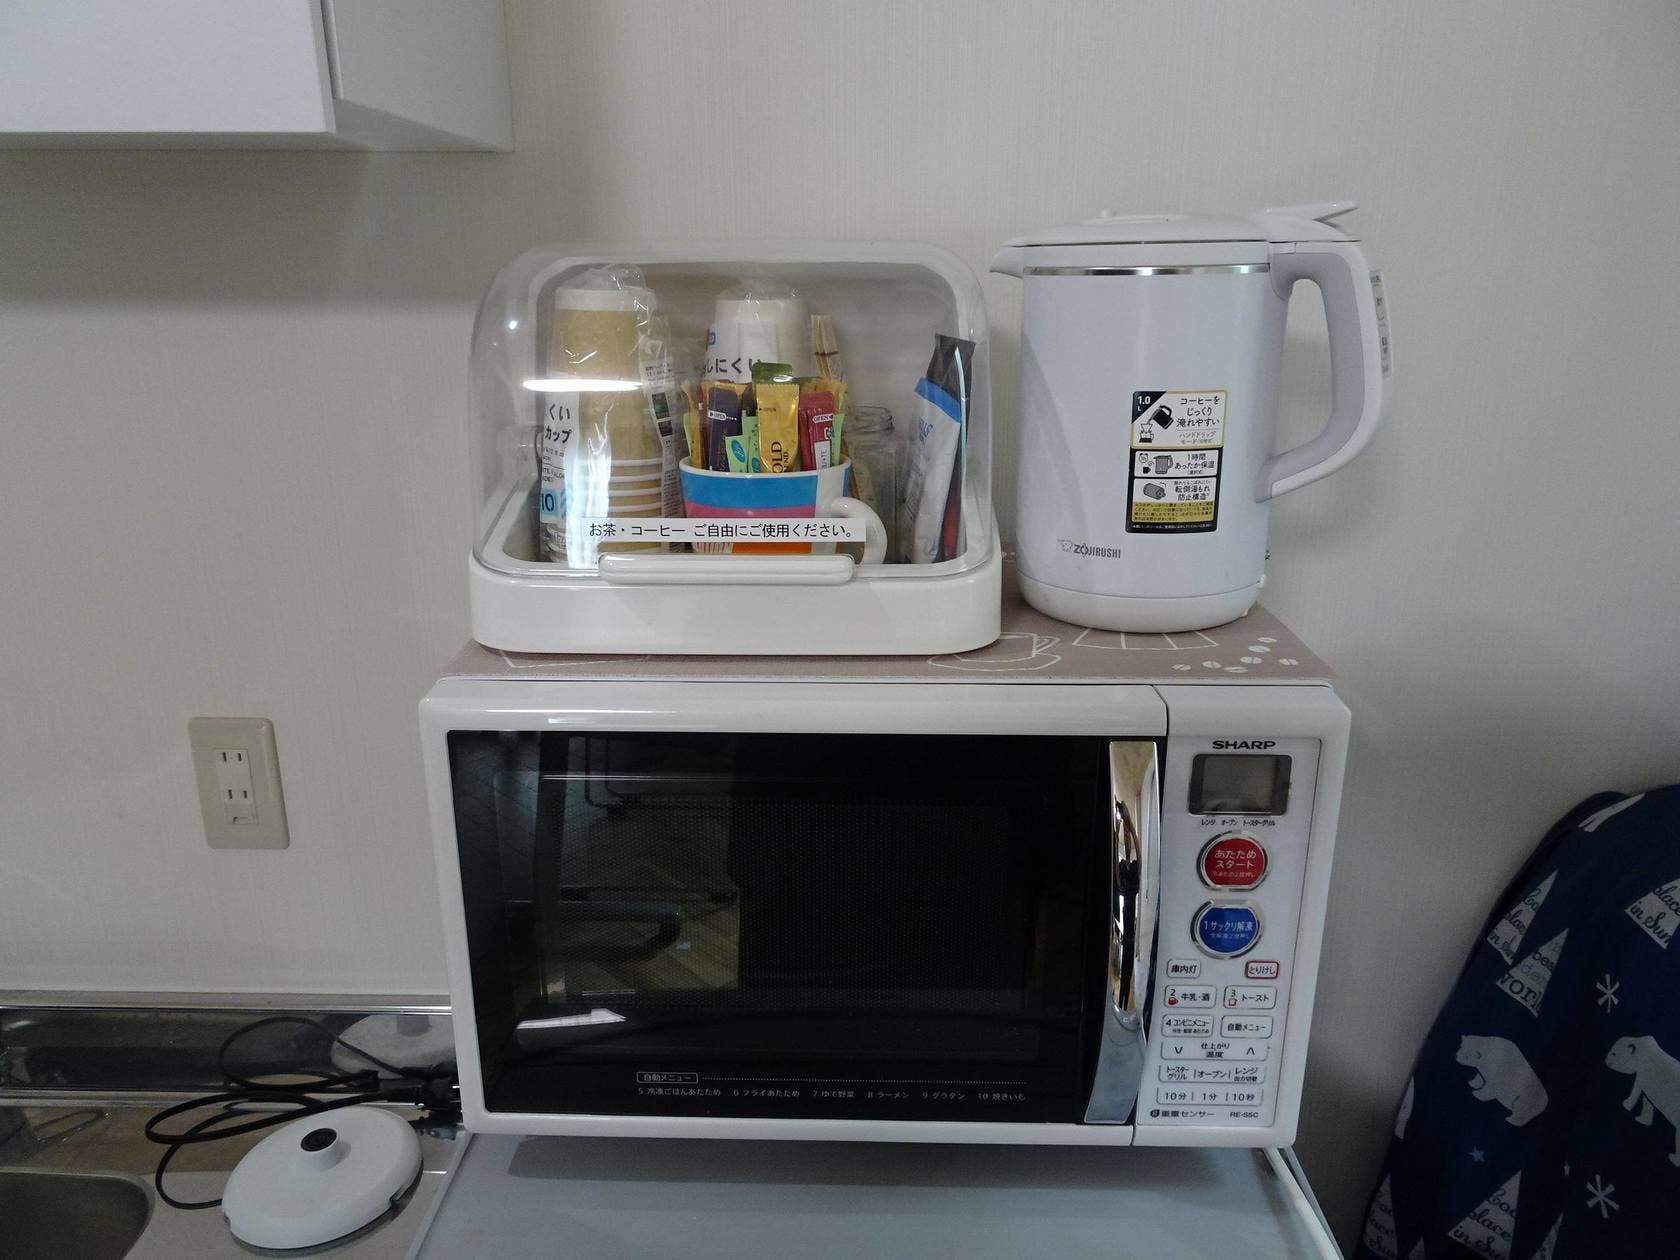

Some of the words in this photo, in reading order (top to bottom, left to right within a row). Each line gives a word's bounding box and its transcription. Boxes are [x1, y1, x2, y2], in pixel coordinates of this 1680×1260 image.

[1138, 396, 1151, 405] 1.0
[1180, 396, 1220, 405] コーヒーを
[1187, 406, 1212, 416] じっくり
[1176, 418, 1220, 428] 淹れやすい
[545, 424, 573, 443] カップ
[771, 441, 783, 473] OLD
[1187, 453, 1206, 461] 1時間
[1174, 460, 1215, 470] あったか保温
[590, 523, 686, 537] お茶・コーヒー
[694, 523, 852, 538] ご自由にご使用ください。
[1073, 543, 1121, 559] ZOJIRUSHI
[1212, 741, 1276, 749] SHARP
[1214, 850, 1257, 859] あたため
[1215, 860, 1254, 869] スタート
[1171, 965, 1197, 974] 庫内灯
[1249, 965, 1275, 976] とりけし
[1181, 993, 1210, 1002] 牛乳・酒
[1231, 989, 1236, 997] 3
[1242, 994, 1270, 1002] トースト
[1173, 1019, 1210, 1027] コンビニメニュー
[1227, 1023, 1266, 1031] 自動メニュー
[1200, 1042, 1230, 1050] 仕上がり
[1206, 1050, 1224, 1058] 温度
[1235, 1066, 1258, 1075] レンジ
[644, 1073, 692, 1082] 自動メニュー
[647, 1087, 721, 1096] 冷凍ごはんあたため
[743, 1088, 801, 1097] フライあたため
[821, 1089, 855, 1098] ゆで野菜
[876, 1090, 910, 1099] ラーメン
[922, 1091, 928, 1099] 9
[933, 1091, 966, 1099] グラタン
[978, 1091, 989, 1100] 10
[991, 1091, 1026, 1101] 焼きいも
[1165, 1092, 1187, 1101] 10分
[1202, 1092, 1217, 1101] 1分
[1233, 1093, 1255, 1101] 10秒
